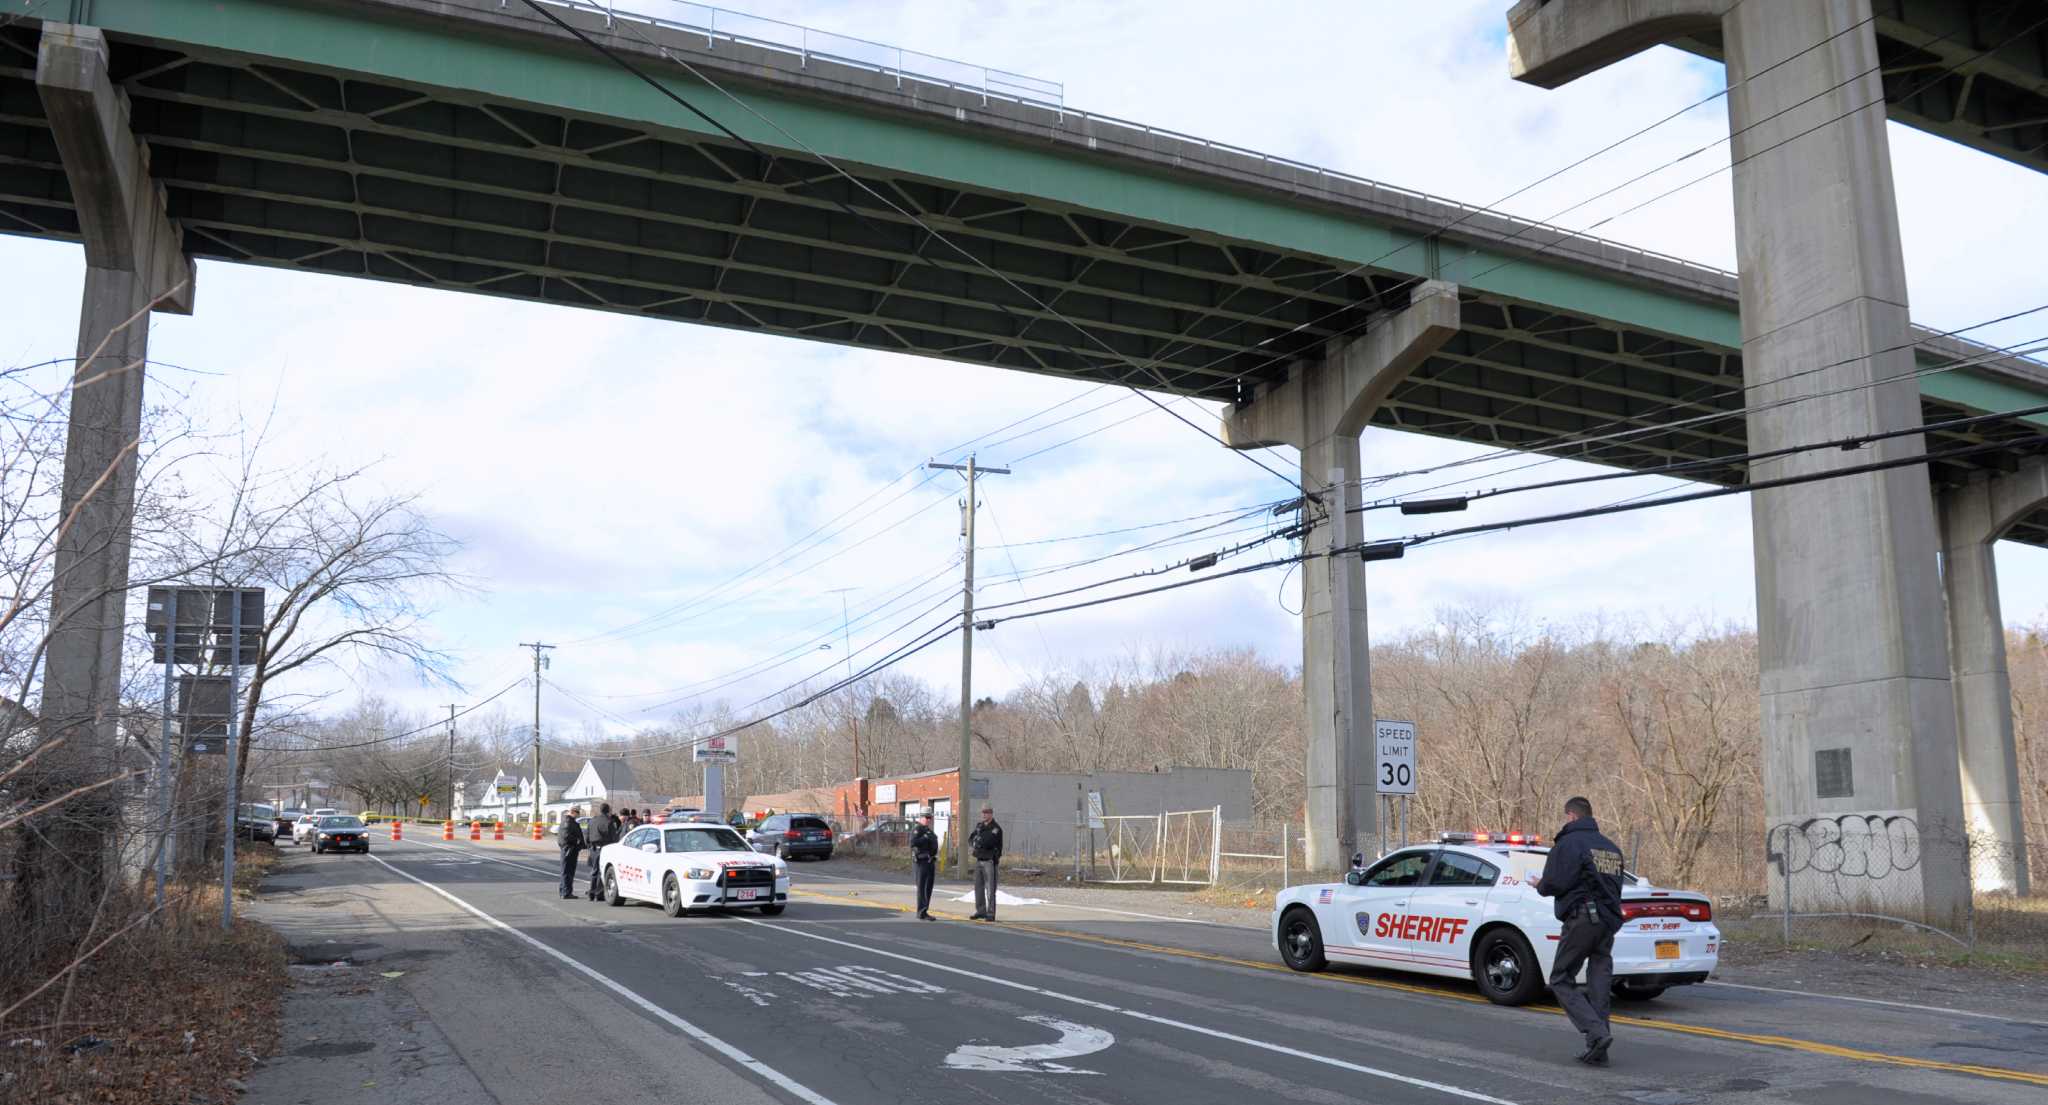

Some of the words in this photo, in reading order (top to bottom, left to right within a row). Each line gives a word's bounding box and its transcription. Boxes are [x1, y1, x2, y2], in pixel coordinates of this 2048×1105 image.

[1379, 728, 1412, 740] SPEED
[1382, 745, 1408, 757] LIMIT
[1382, 762, 1410, 786] 30
[1375, 912, 1469, 944] SHERIFF
